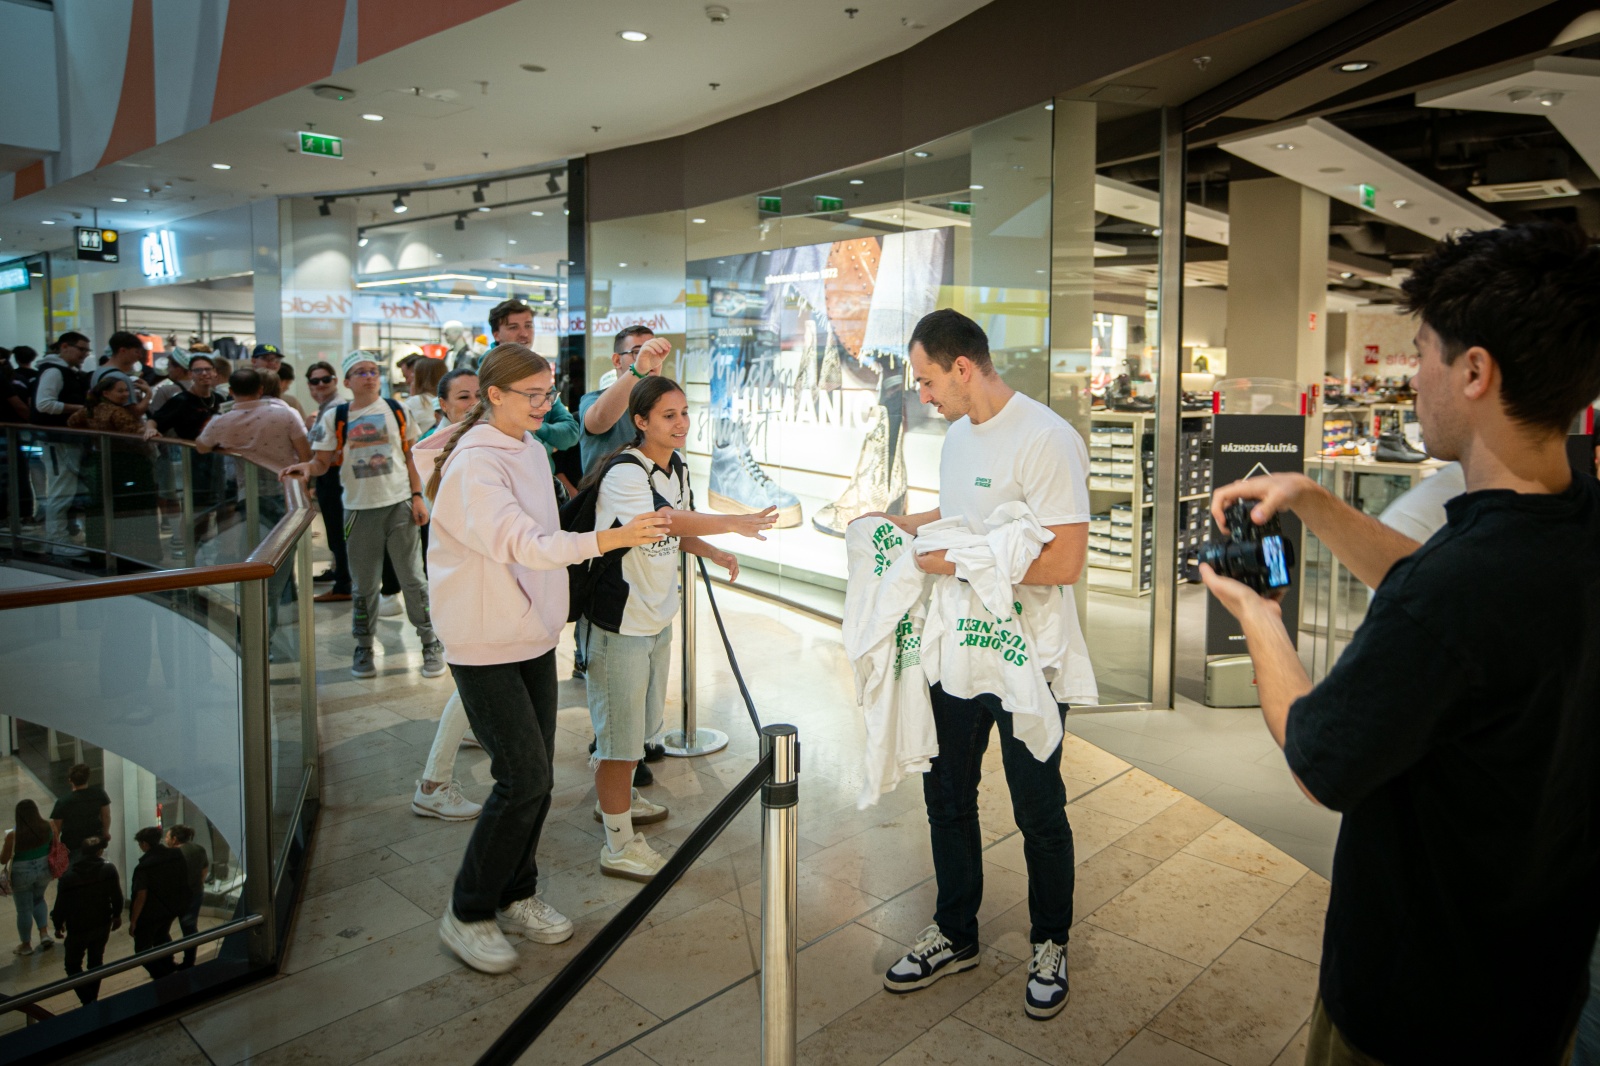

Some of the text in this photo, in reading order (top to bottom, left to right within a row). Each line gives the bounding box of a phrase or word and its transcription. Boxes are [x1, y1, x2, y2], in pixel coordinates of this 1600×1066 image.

[103, 254, 118, 262] WC
[732, 386, 877, 431] HUMANIC
[1221, 442, 1298, 453] HÁZHOZSZÁLLÍTÁS
[960, 633, 1029, 667] SO ORRY
